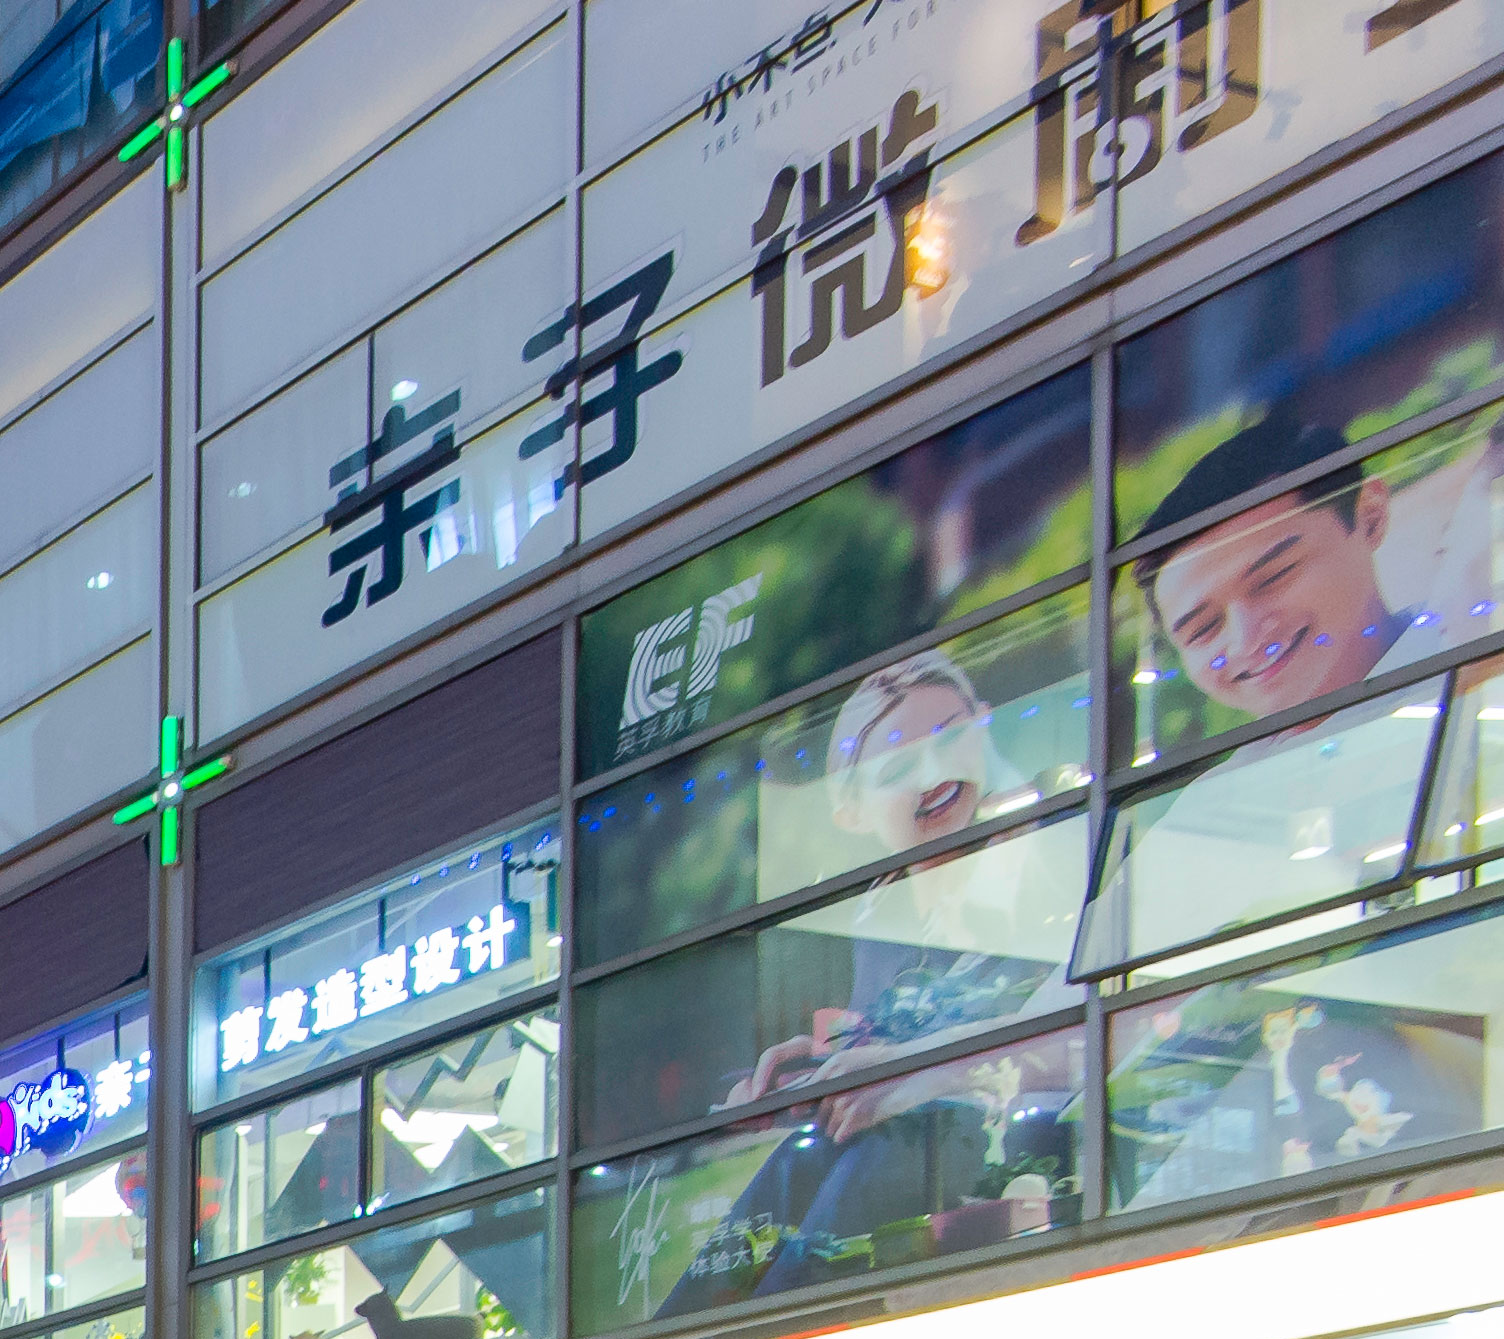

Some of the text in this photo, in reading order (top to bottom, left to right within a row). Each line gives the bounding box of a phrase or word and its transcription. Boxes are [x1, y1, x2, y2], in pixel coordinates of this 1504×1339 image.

[701, 123, 742, 164] THE
[754, 88, 796, 132] ART
[806, 33, 879, 97] SPACE
[321, 0, 1463, 628] 亲子微剧
[620, 571, 763, 732] EF
[614, 694, 713, 763] 英孚教育
